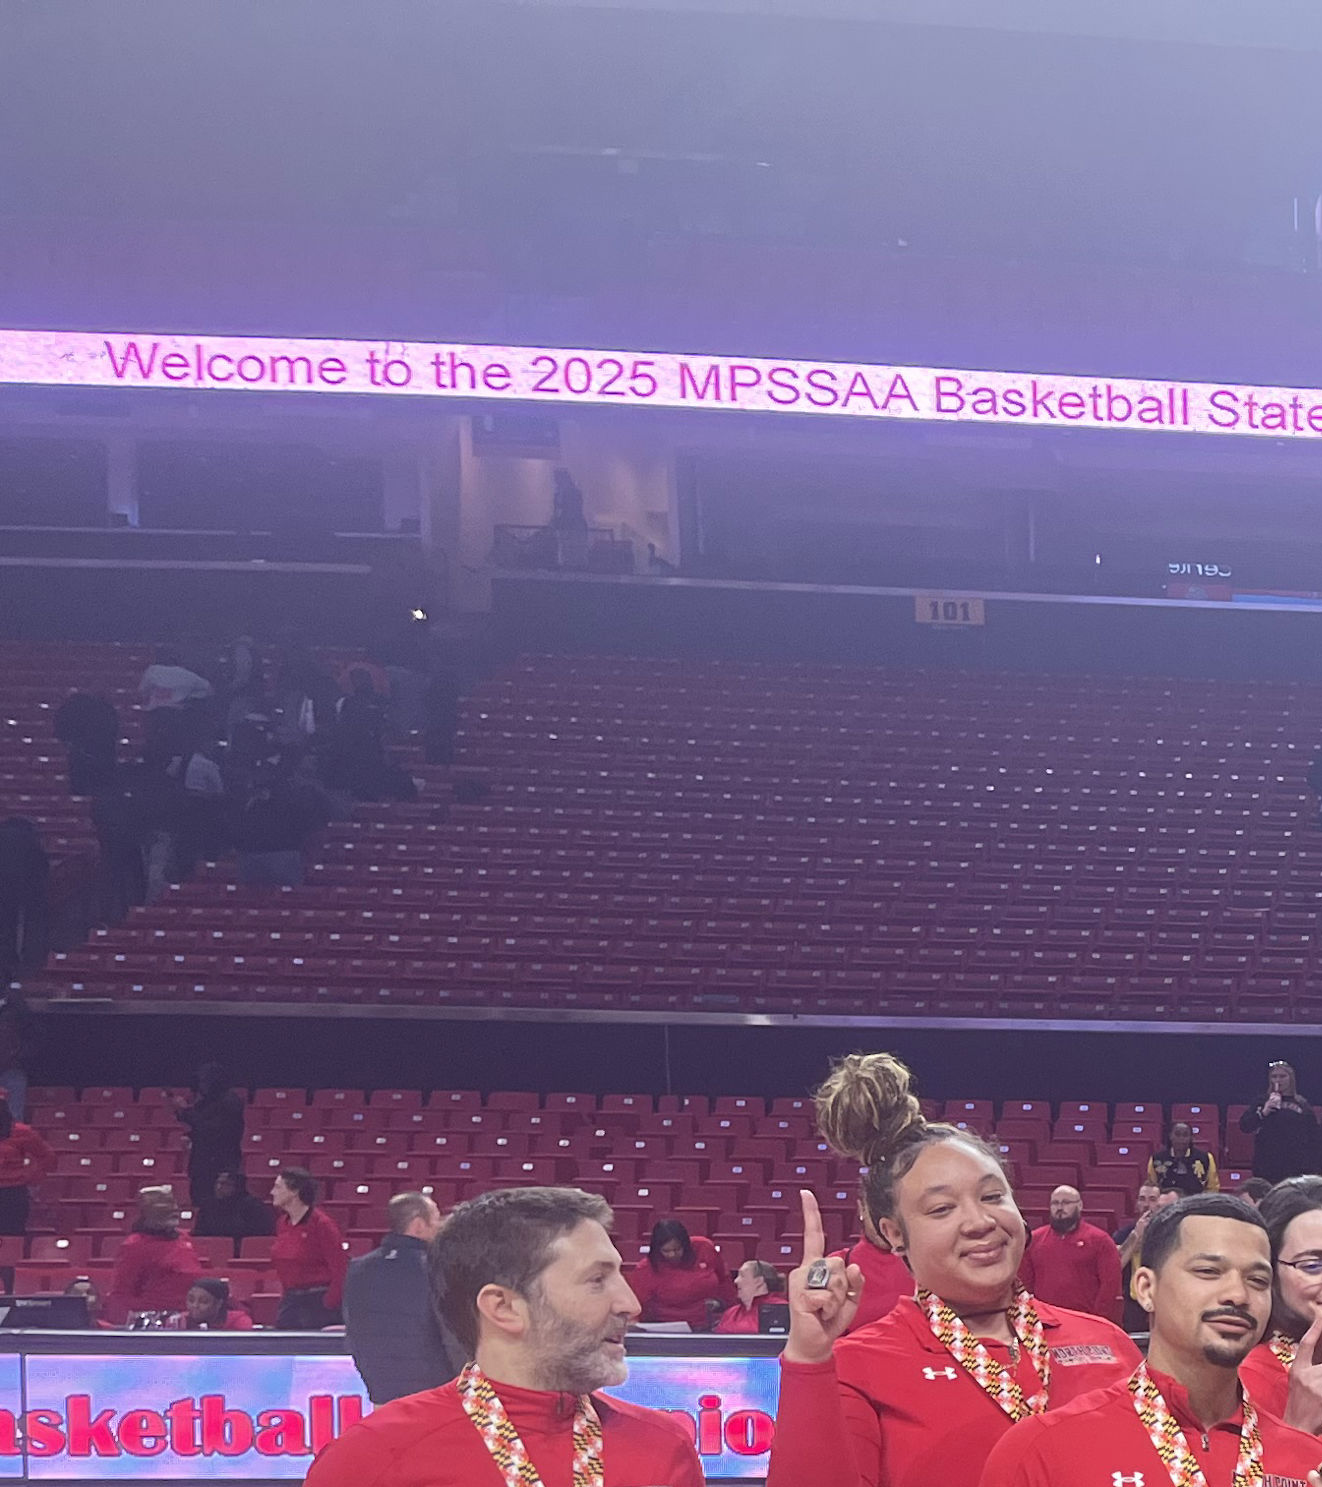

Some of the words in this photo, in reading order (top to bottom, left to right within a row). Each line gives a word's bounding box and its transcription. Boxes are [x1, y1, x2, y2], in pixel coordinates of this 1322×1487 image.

[103, 340, 348, 385] Welcome
[366, 351, 412, 387] to
[431, 352, 512, 391] the
[531, 355, 658, 398] 2025
[679, 361, 920, 412] MPSSAA
[935, 376, 1189, 426] Basketball
[928, 599, 971, 622] 101
